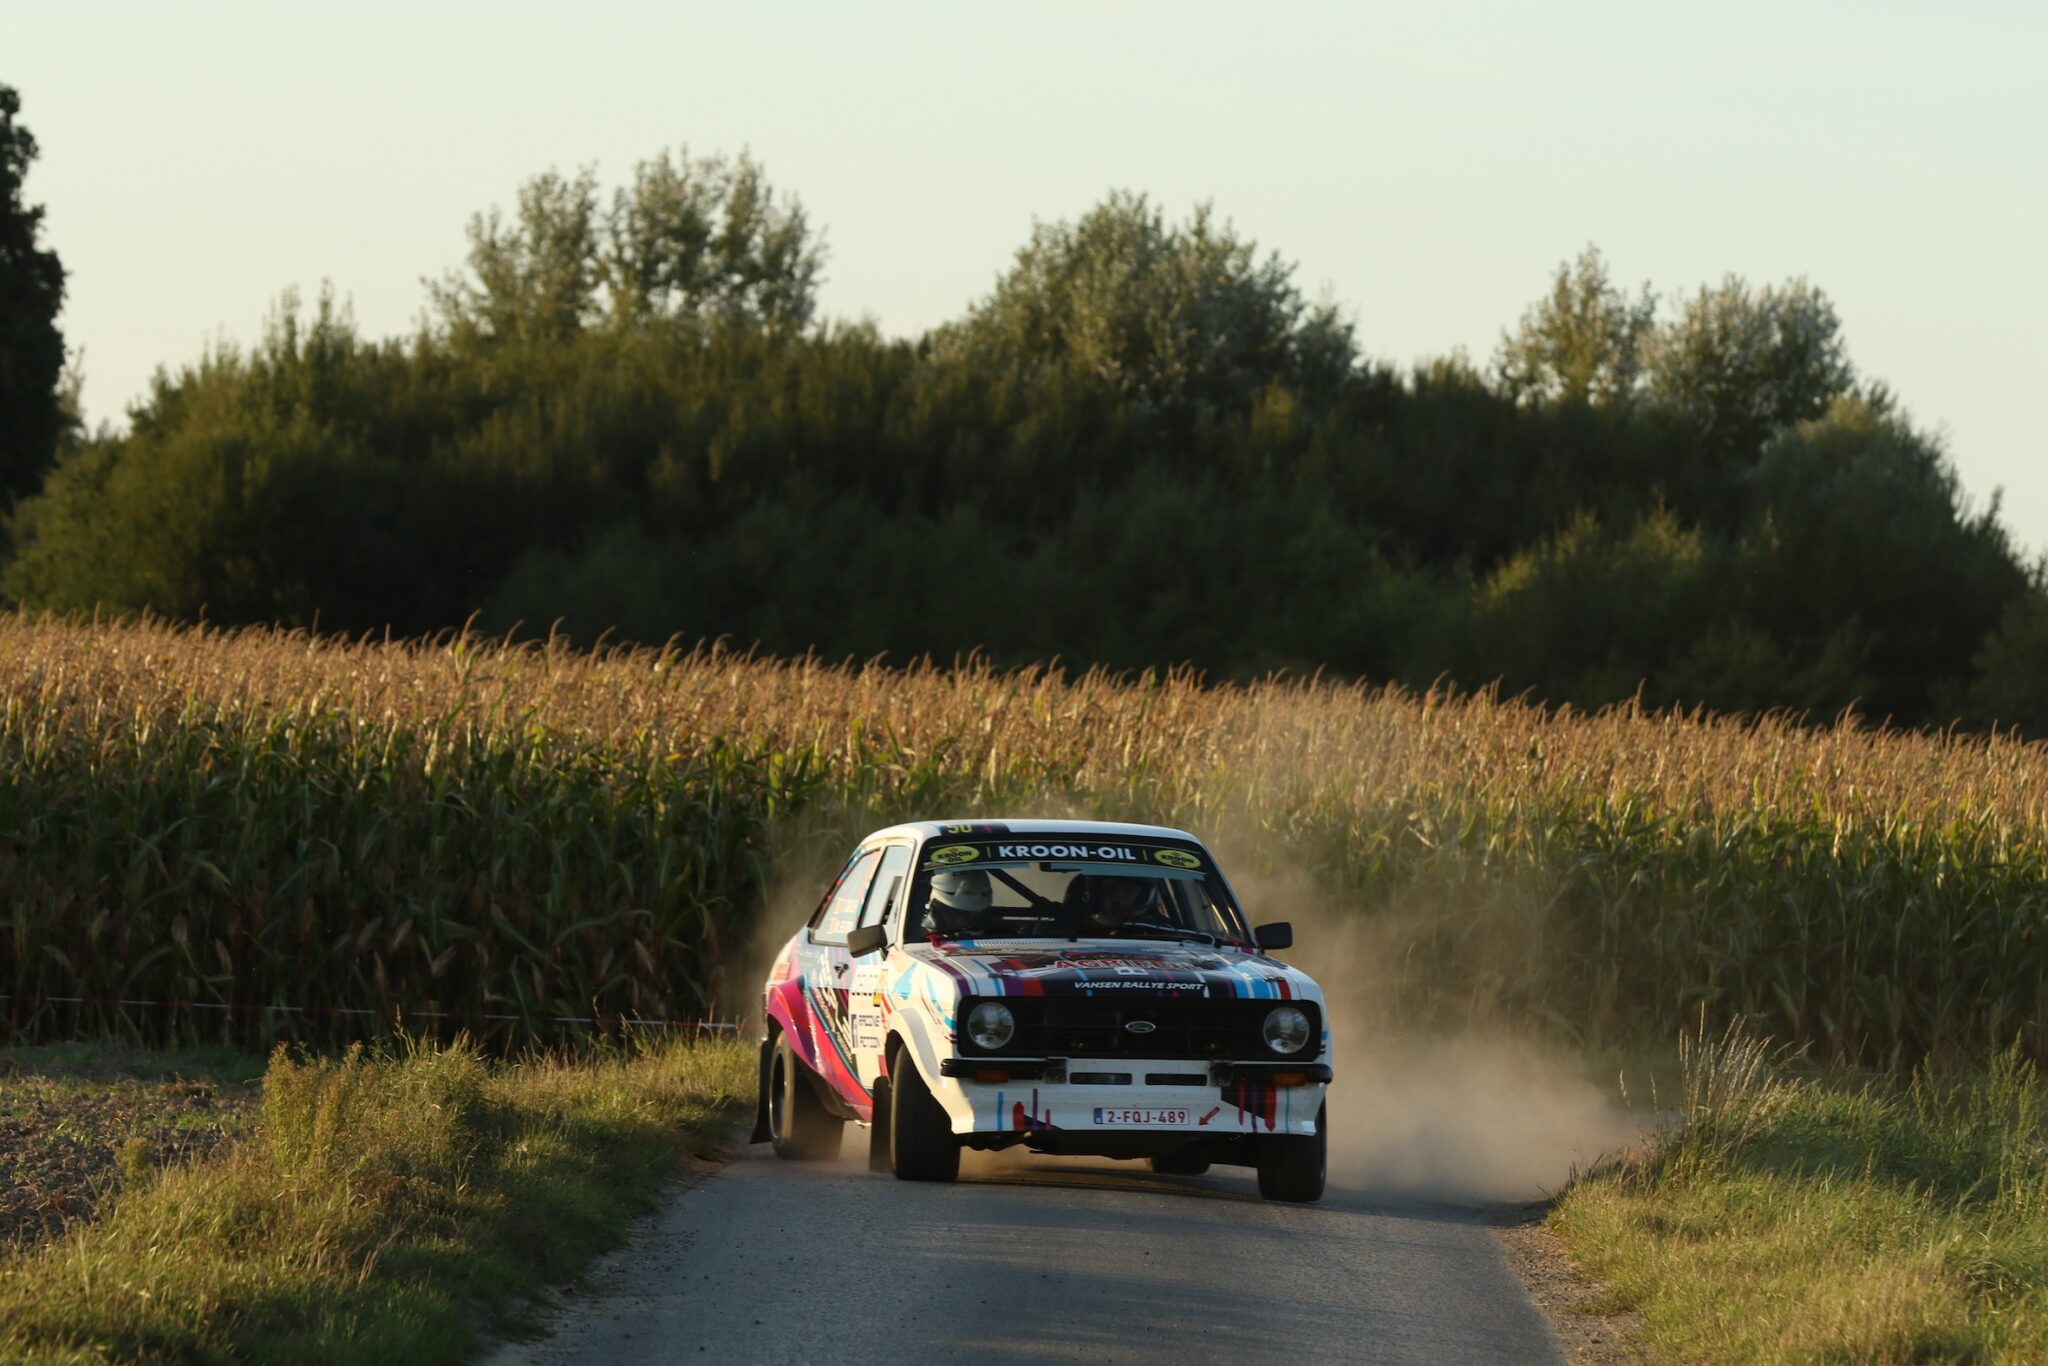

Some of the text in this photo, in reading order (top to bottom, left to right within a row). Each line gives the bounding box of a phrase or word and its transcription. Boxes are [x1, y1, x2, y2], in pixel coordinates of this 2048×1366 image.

[998, 845, 1137, 860] KROON-OIL
[1122, 981, 1165, 989] RALLYE
[1166, 982, 1204, 990] SPORT
[1107, 1111, 1186, 1123] 2-FQJ-489
